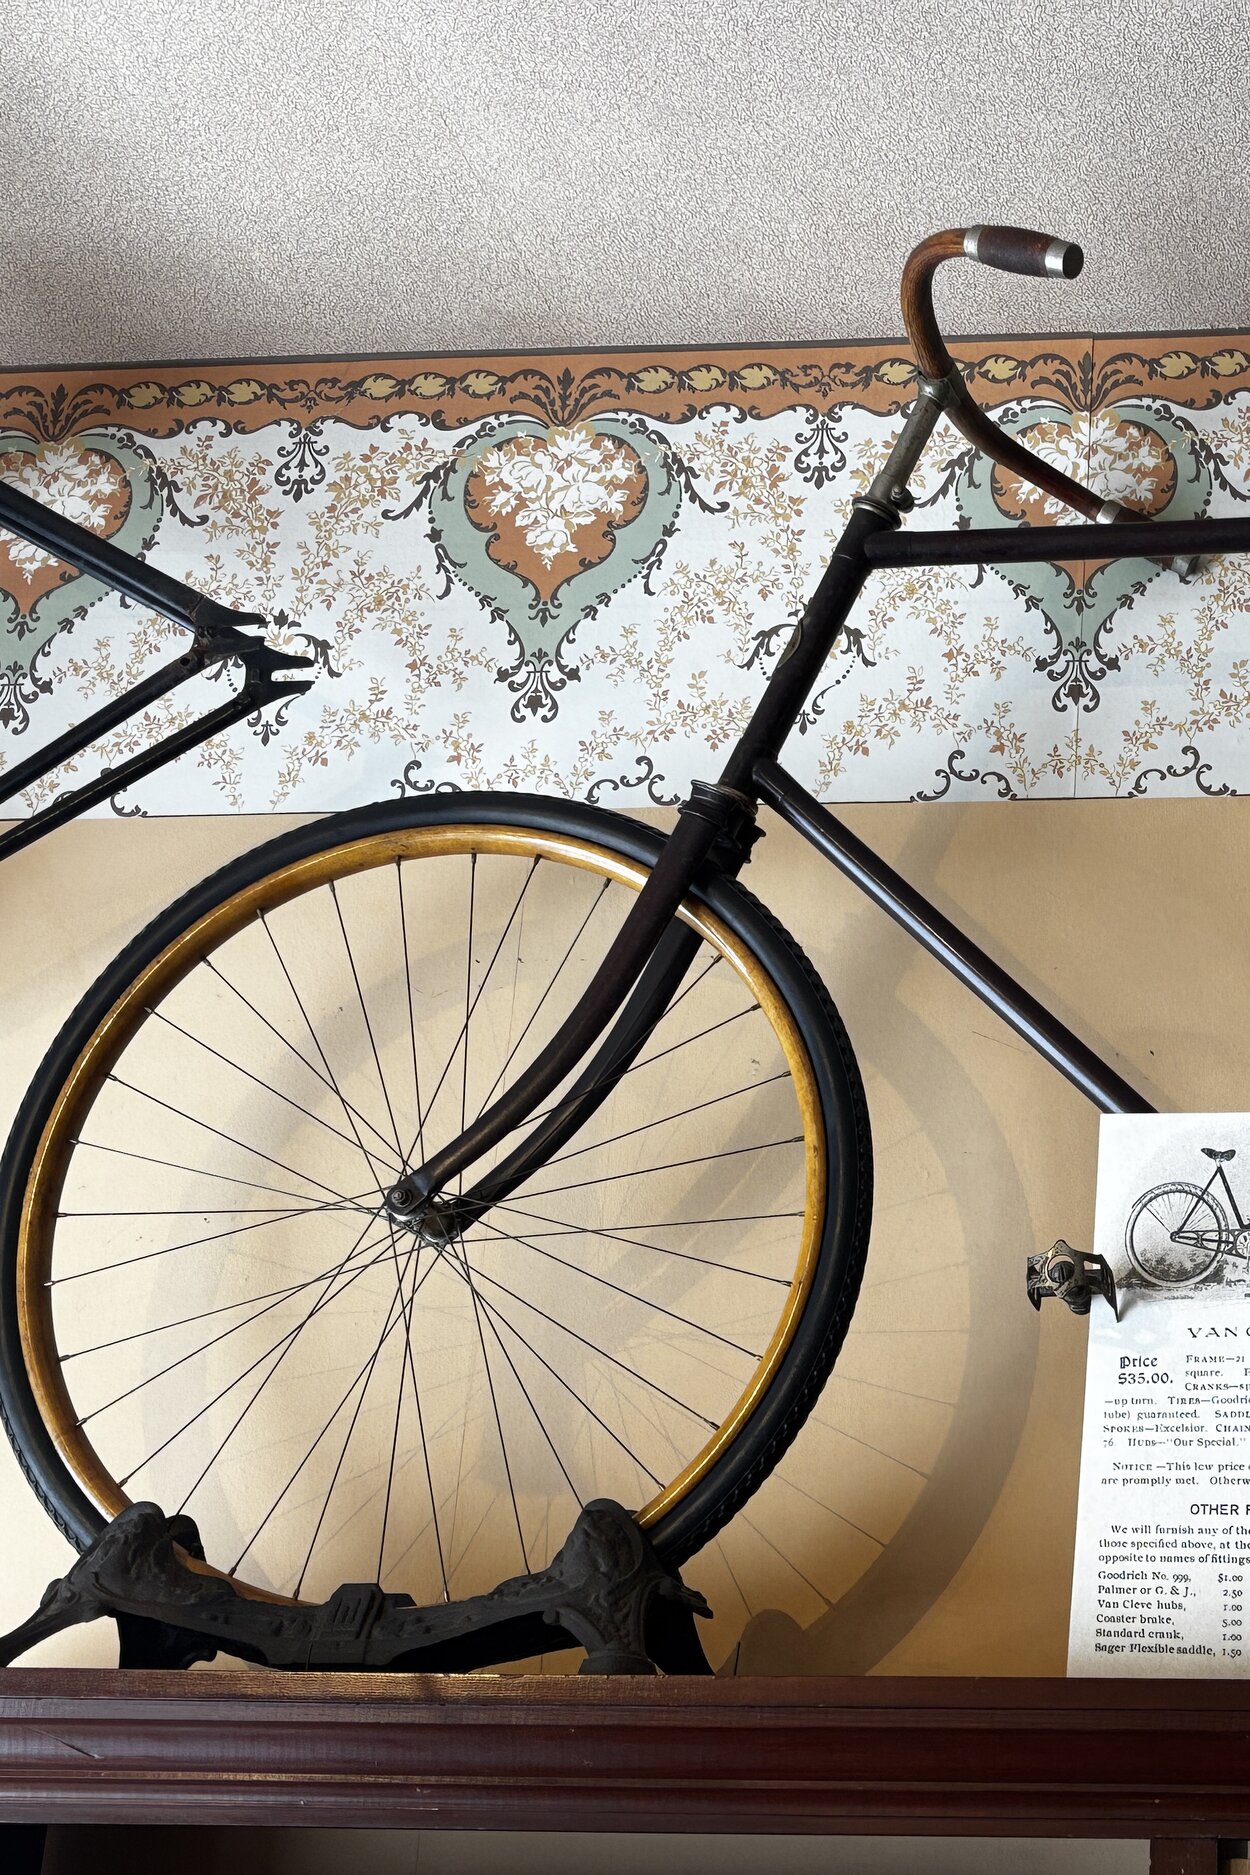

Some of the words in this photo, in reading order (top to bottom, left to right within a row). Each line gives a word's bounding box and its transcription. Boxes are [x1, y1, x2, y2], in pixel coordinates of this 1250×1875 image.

[1187, 1327, 1237, 1338] VAN
[1120, 1355, 1157, 1369] Price
[1118, 1372, 1173, 1385] $35.00.
[1185, 1370, 1223, 1379] square.
[1104, 1410, 1130, 1419] tube)
[1137, 1409, 1200, 1420] guaranteed.
[1194, 1462, 1213, 1470] low
[1218, 1462, 1245, 1473] price
[1122, 1476, 1171, 1487] promptly
[1176, 1477, 1199, 1485] met.
[1190, 1504, 1239, 1515] OTHER
[1111, 1525, 1127, 1534] We
[1132, 1525, 1151, 1534] will
[1156, 1525, 1194, 1534] furnish
[1198, 1528, 1218, 1536] any
[1222, 1525, 1237, 1535] of
[1099, 1539, 1128, 1548] those
[1131, 1539, 1177, 1550] specified
[1181, 1540, 1216, 1550] above,
[1220, 1541, 1230, 1549] at
[1099, 1553, 1143, 1564] opposite
[1146, 1554, 1156, 1562] to
[1198, 1554, 1213, 1563] of
[1211, 1554, 1250, 1566] fittings
[1098, 1570, 1147, 1580] Goodrich
[1152, 1572, 1169, 1580] No.
[1173, 1574, 1191, 1583] 999,
[1218, 1573, 1243, 1583] $1.00
[1098, 1585, 1137, 1594] Palmer
[1155, 1586, 1167, 1595] G.
[1170, 1586, 1180, 1595] &
[1223, 1589, 1243, 1599] 2.50
[1097, 1599, 1119, 1608] Van
[1123, 1599, 1152, 1609] Cleve
[1157, 1600, 1186, 1612] hubs,
[1224, 1604, 1242, 1612] 1.00
[1096, 1614, 1137, 1623] Coaster
[1140, 1614, 1175, 1626] brake,
[1222, 1619, 1242, 1628] 5.00
[1096, 1628, 1145, 1640] Standard
[1148, 1629, 1184, 1642] crank,
[1095, 1643, 1129, 1654] Sager
[1128, 1642, 1175, 1654] Flexible
[1176, 1645, 1215, 1657] saddle,
[1222, 1646, 1243, 1659] 1.50
